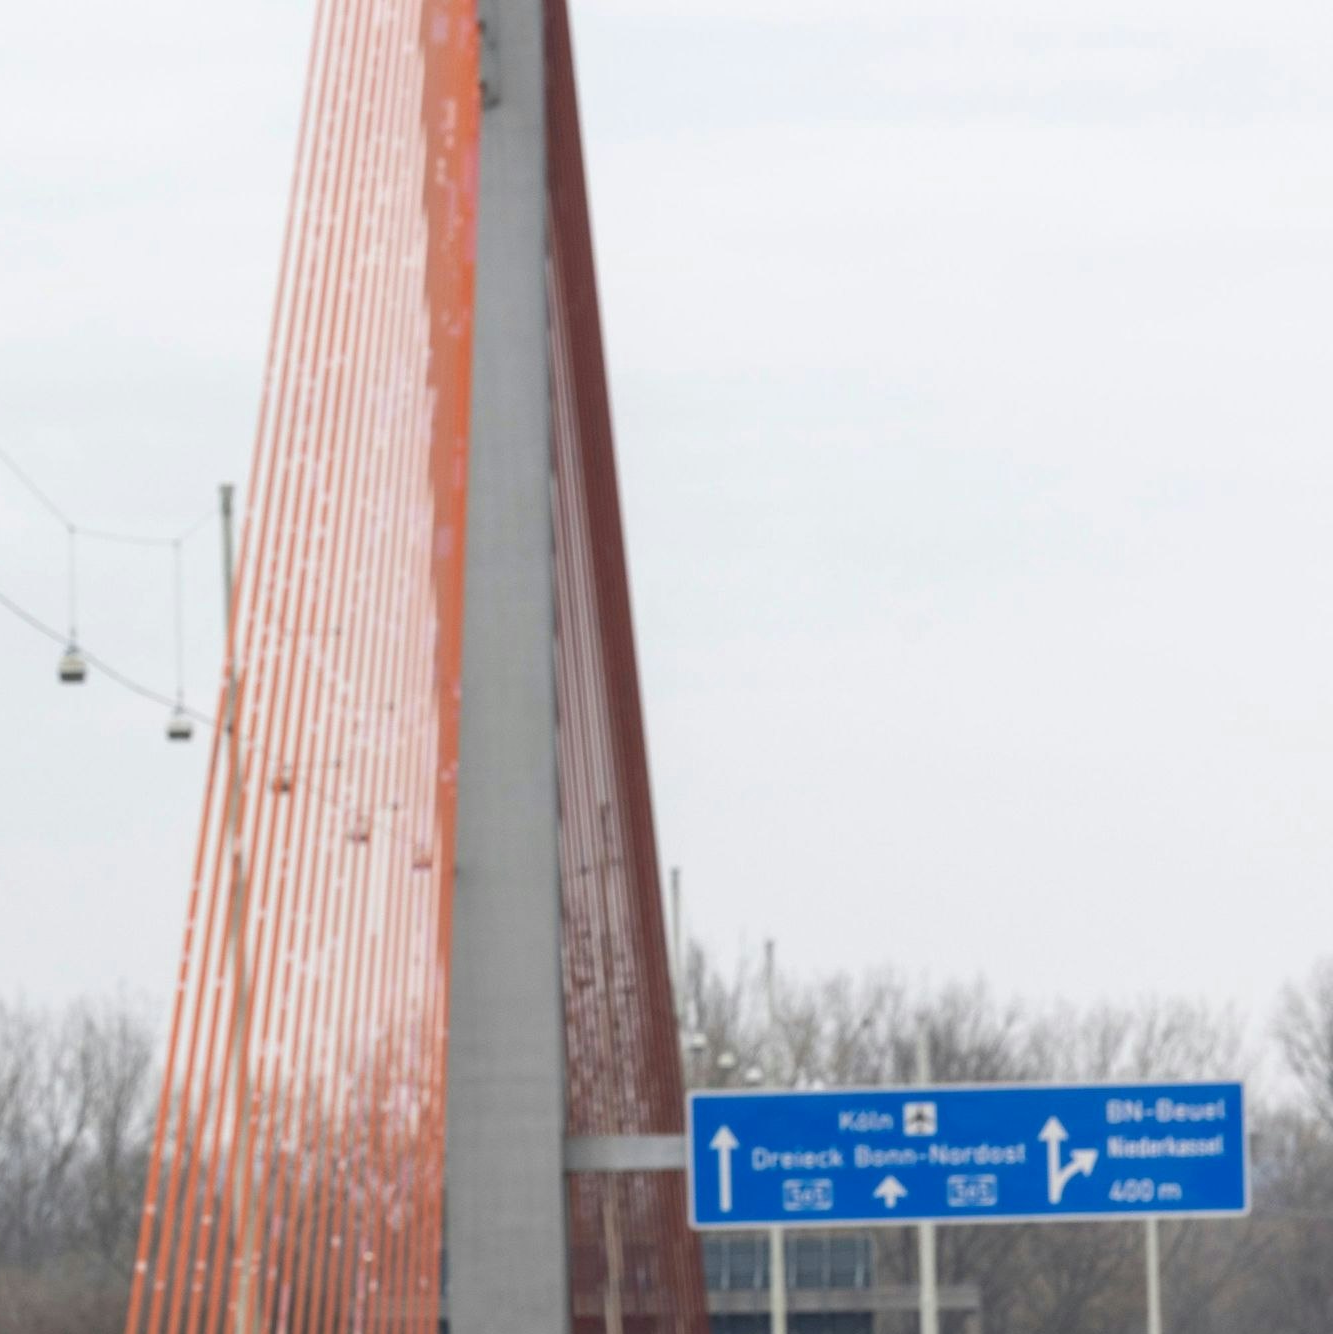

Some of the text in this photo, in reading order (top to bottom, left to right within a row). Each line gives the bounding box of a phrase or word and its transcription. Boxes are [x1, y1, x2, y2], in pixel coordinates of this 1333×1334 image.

[838, 1110, 894, 1132] Köln
[1106, 1097, 1226, 1124] BN-Beuel
[751, 1143, 1026, 1171] Dreieck Bonn-Nordost
[1106, 1133, 1225, 1158] Niederkassel
[1109, 1178, 1182, 1202] 400 m
